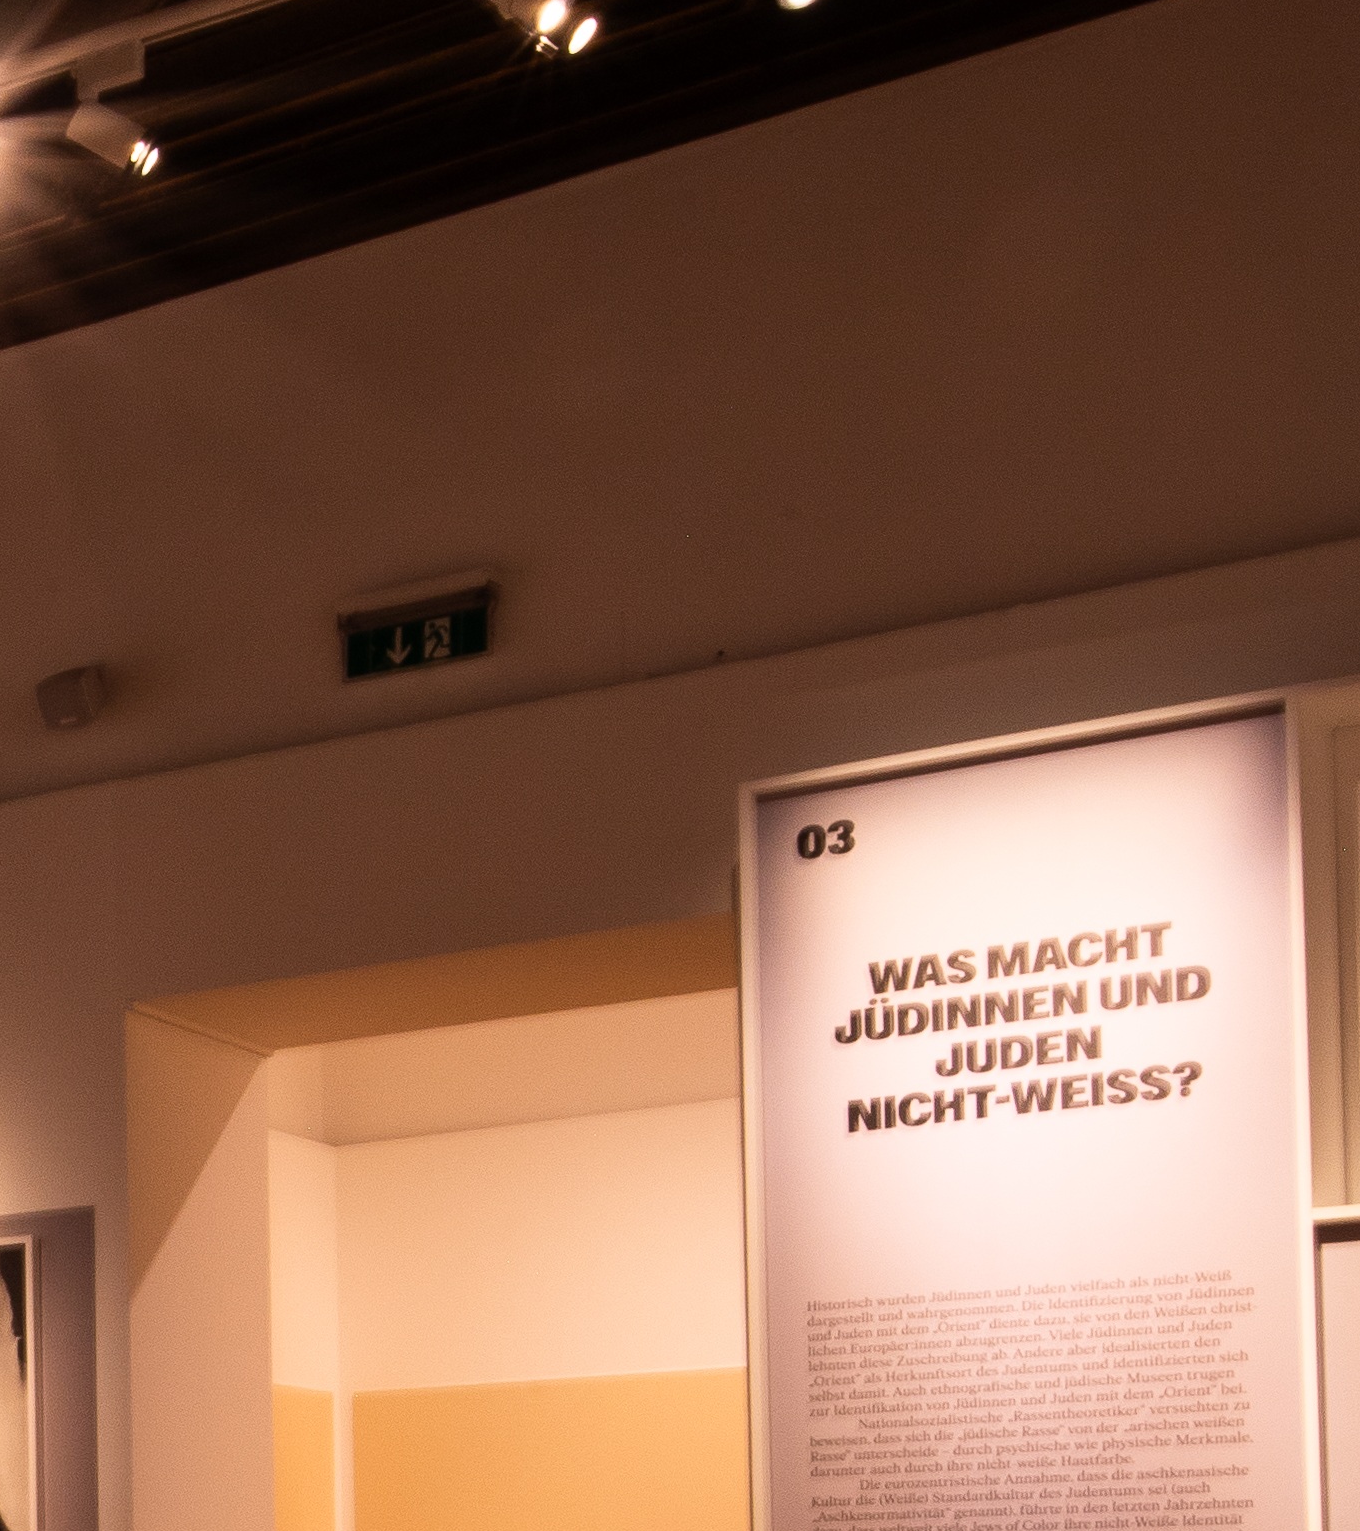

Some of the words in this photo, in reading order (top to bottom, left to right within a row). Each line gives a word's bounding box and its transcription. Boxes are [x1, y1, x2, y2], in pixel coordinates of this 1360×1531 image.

[797, 819, 856, 860] 03
[868, 949, 977, 995] WAS
[987, 920, 1172, 980] MACHT
[834, 980, 1088, 1044] JÜDINNEN
[1100, 965, 1212, 1010] UND
[935, 1025, 1102, 1077] JUDEN
[847, 1060, 1203, 1133] NICHT-WEISS?
[806, 1297, 873, 1312] Historisch
[876, 1293, 926, 1307] wurden
[929, 1288, 992, 1303] Jüdinnen
[995, 1286, 1022, 1299] und
[1024, 1283, 1066, 1297] Juden
[1070, 1279, 1126, 1293] vielfach
[1129, 1277, 1149, 1289] als
[806, 1312, 874, 1330] dargestellt
[878, 1310, 904, 1322] und
[1021, 1301, 1043, 1313] Die
[1157, 1293, 1182, 1303] von
[1186, 1286, 1256, 1301] Jüdinnen
[807, 1331, 832, 1342] und
[834, 1328, 873, 1341] Juden
[876, 1326, 897, 1338] mit
[900, 1324, 929, 1336] dem
[988, 1317, 1029, 1331] diente
[1074, 1313, 1090, 1325] sie
[1096, 1314, 1120, 1324] von
[1123, 1309, 1150, 1322] den
[1154, 1306, 1207, 1320] Weißen
[807, 1345, 846, 1357] lichen
[1049, 1330, 1082, 1342] Viele
[1086, 1325, 1153, 1340] Jüdinnen
[1157, 1323, 1185, 1336] und
[1188, 1320, 1233, 1334] Juden
[807, 1360, 856, 1373] lehnten
[859, 1357, 892, 1370] diese
[897, 1352, 987, 1370] Zuschreibung
[1014, 1347, 1062, 1360] Andere
[1067, 1345, 1097, 1357] aber
[1102, 1339, 1190, 1355] idealisierten
[1193, 1337, 1221, 1350] den
[865, 1373, 881, 1385] als
[885, 1368, 971, 1383] Herkunftsort
[976, 1367, 998, 1378] des
[1002, 1362, 1076, 1377] Judentums
[1083, 1360, 1109, 1372] und
[1220, 1352, 1250, 1364] sich
[808, 1391, 845, 1403] selbst
[892, 1386, 927, 1398] Auch
[1034, 1379, 1061, 1391] und
[1064, 1375, 1121, 1392] jüdische
[1127, 1372, 1183, 1386] Museen
[1186, 1369, 1235, 1385] trugen
[809, 1409, 830, 1418] zur
[926, 1403, 950, 1412] von
[953, 1397, 1016, 1411] Jüdinnen
[1020, 1395, 1047, 1407] und
[1050, 1393, 1092, 1406] Juden
[1096, 1392, 1119, 1403] mit
[1123, 1390, 1154, 1402] dem
[1149, 1402, 1229, 1417] versuchten
[1233, 1403, 1251, 1413] zu
[873, 1434, 901, 1445] dass
[905, 1432, 931, 1444] sich
[933, 1431, 953, 1443] die
[1068, 1427, 1093, 1436] von
[1095, 1424, 1119, 1435] der
[1193, 1418, 1245, 1431] weißen
[810, 1466, 866, 1479] darunter
[870, 1465, 901, 1476] auch
[904, 1463, 943, 1475] durch
[946, 1462, 972, 1473] ihre
[859, 1481, 881, 1492] Die
[1077, 1472, 1107, 1484] dass
[1111, 1471, 1132, 1482] die
[1019, 1505, 1062, 1517] führte
[1065, 1505, 1079, 1516] in
[1082, 1504, 1108, 1515] den
[1112, 1502, 1160, 1514] letzten
[1163, 1499, 1255, 1512] Jahrzehnten
